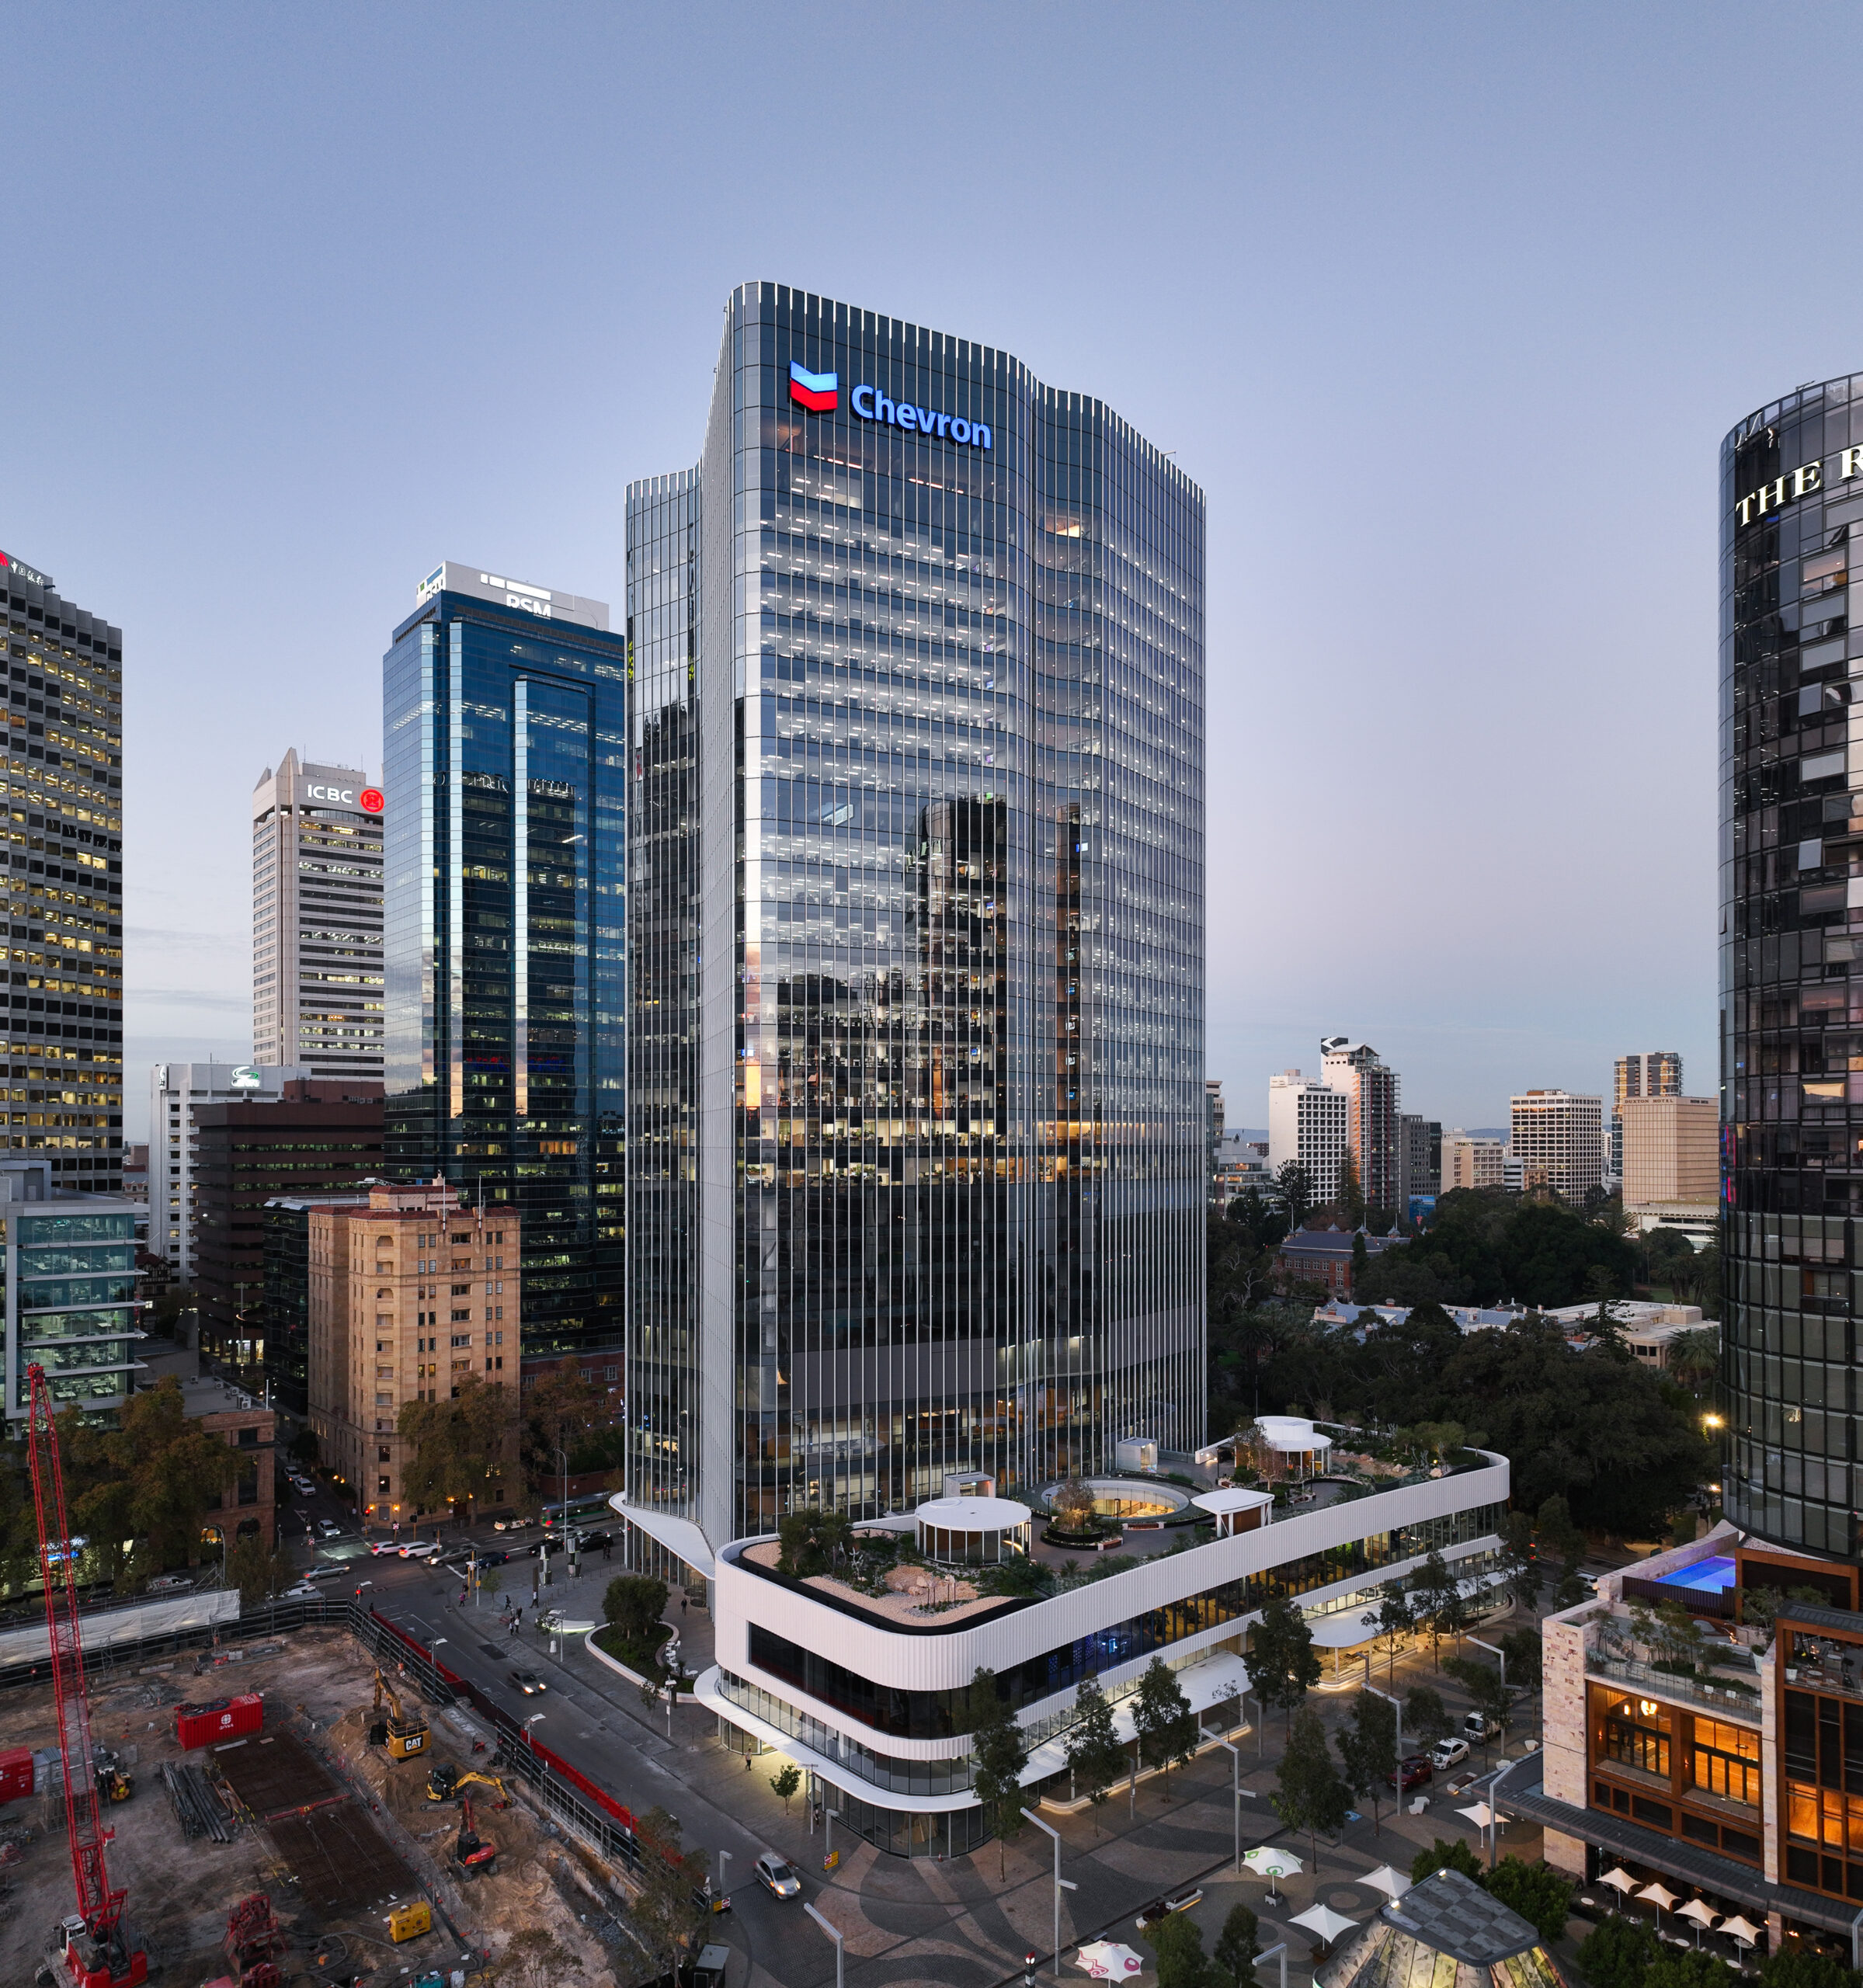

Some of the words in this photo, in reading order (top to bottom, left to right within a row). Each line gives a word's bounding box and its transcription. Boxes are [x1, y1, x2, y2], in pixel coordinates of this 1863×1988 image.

[851, 384, 992, 449] Chevron
[1735, 461, 1821, 527] THE
[506, 593, 551, 617] RSM
[308, 784, 353, 805] ICBC
[405, 1736, 422, 1750] CAT
